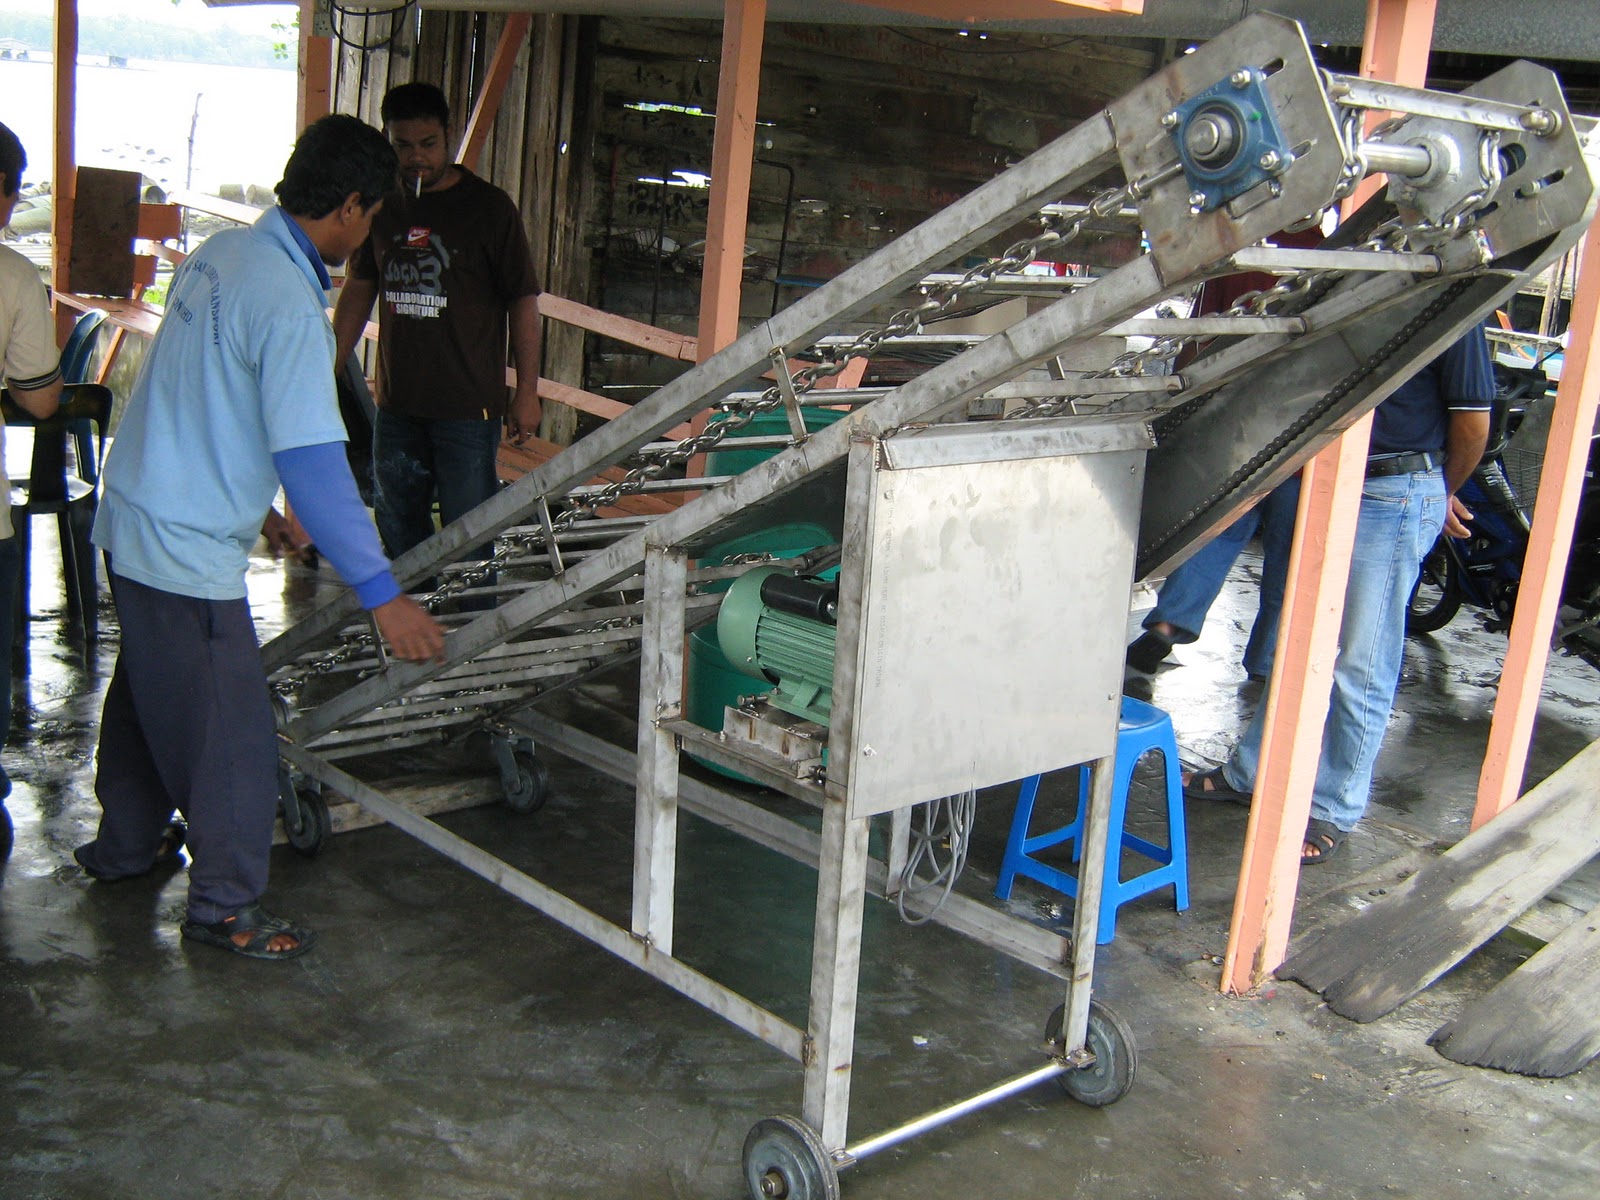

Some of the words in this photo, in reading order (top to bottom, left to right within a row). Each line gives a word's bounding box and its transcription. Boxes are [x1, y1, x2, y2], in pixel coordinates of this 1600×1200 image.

[386, 291, 447, 308] COLLABORATION
[211, 282, 220, 345] TRANSPORT
[396, 304, 440, 318] SIGNATURE
